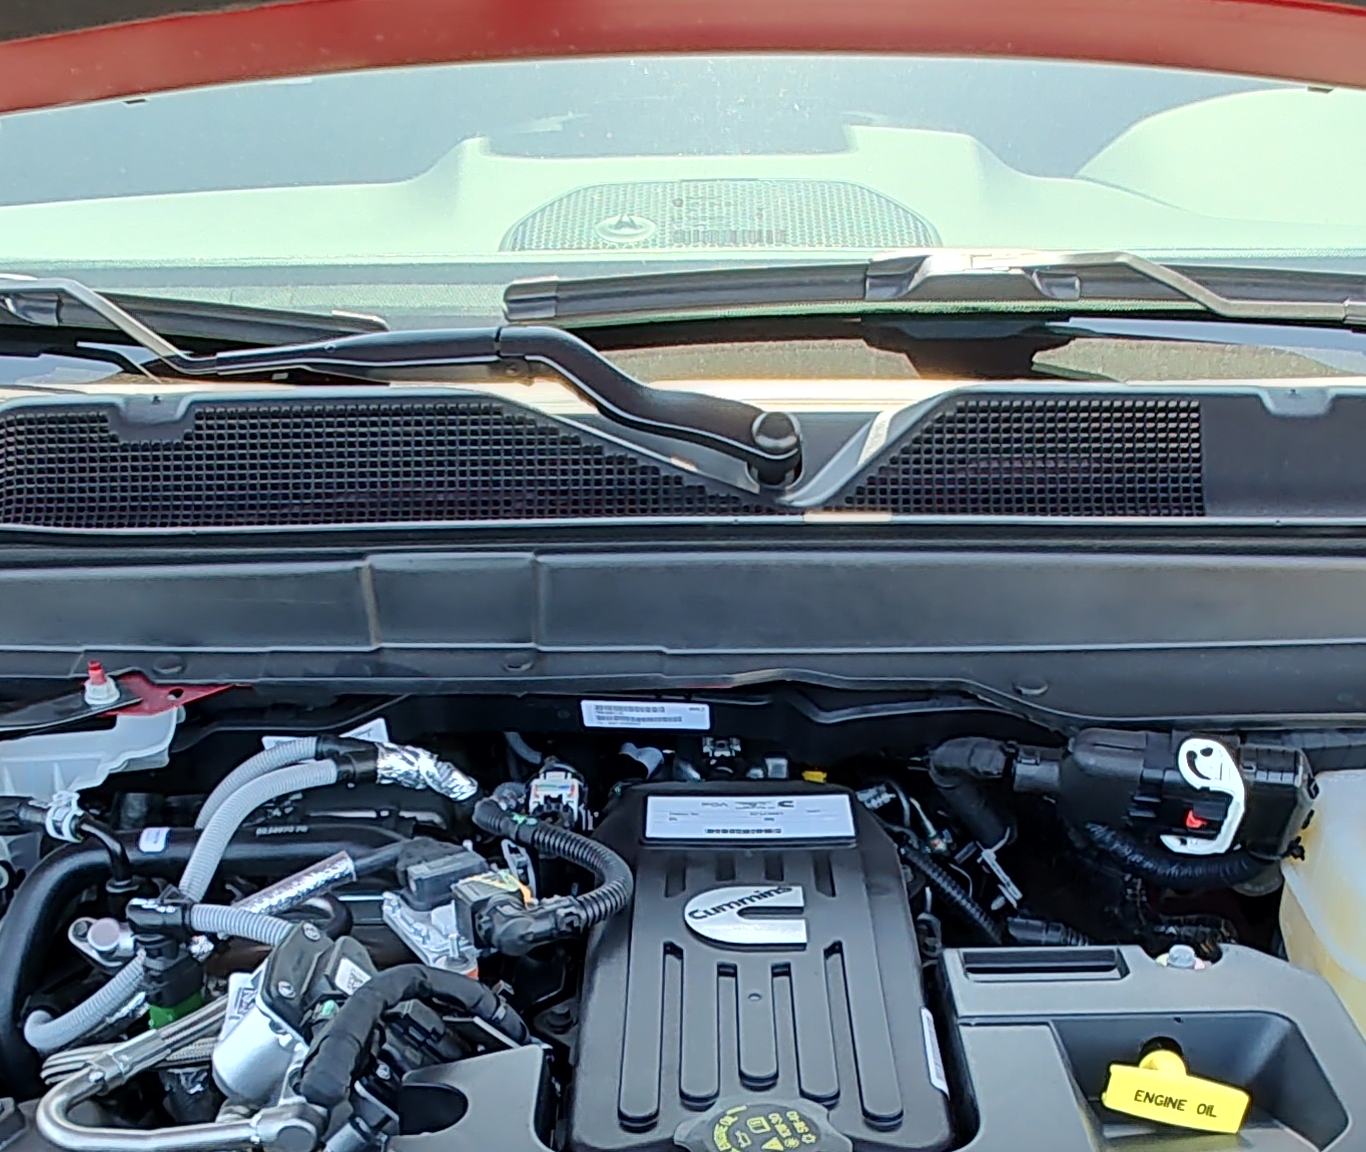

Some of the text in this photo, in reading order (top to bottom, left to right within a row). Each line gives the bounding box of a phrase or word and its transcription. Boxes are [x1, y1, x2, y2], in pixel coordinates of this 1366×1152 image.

[688, 886, 793, 920] Cummins
[1133, 1089, 1218, 1118] ENGINE OIL
[719, 1114, 739, 1126] OIL
[713, 1123, 732, 1152] ENGINE
